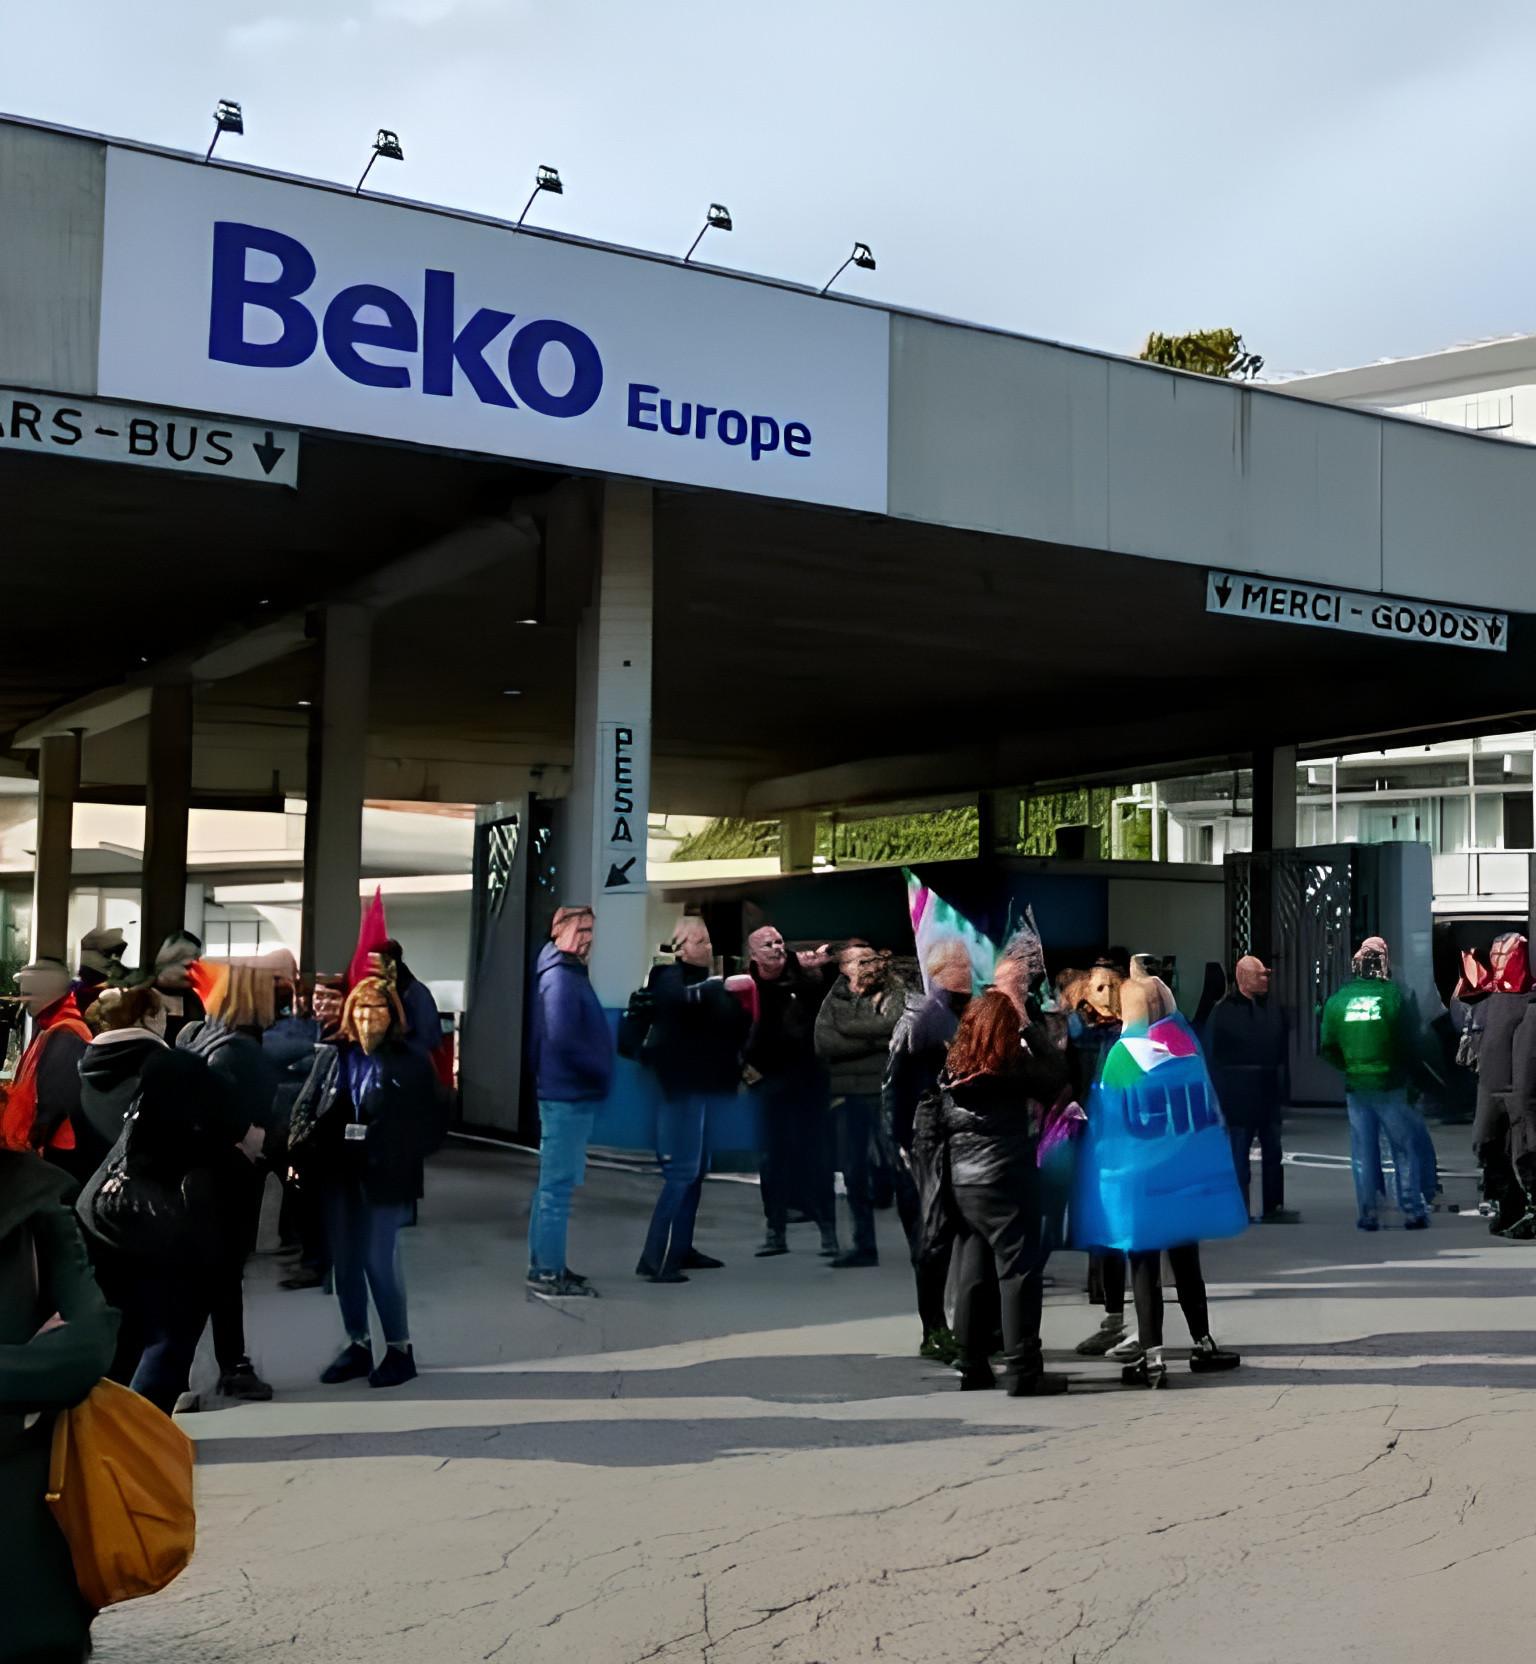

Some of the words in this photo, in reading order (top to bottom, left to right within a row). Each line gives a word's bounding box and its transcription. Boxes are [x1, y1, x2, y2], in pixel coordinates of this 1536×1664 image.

[208, 221, 603, 418] Beko
[628, 383, 812, 460] Europe
[0, 400, 233, 466] RS-BUS
[1241, 583, 1341, 623] MERCI
[1371, 605, 1479, 642] GOODS
[611, 728, 633, 842] PESA
